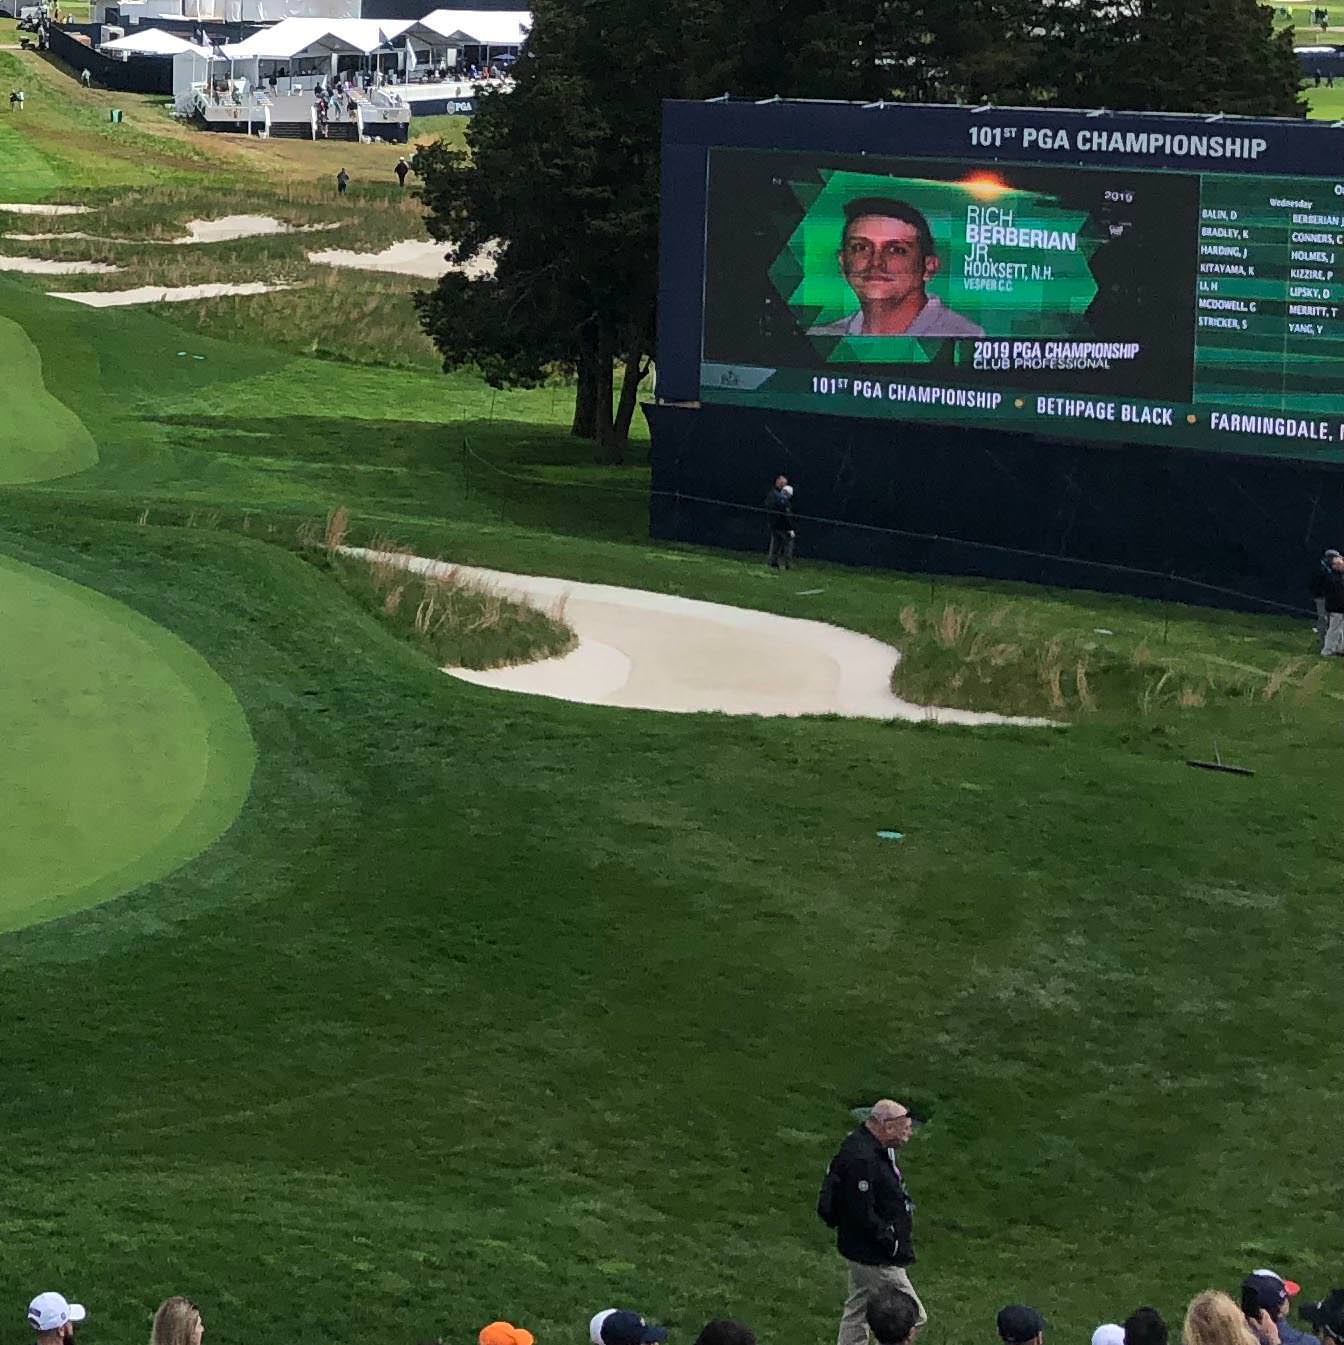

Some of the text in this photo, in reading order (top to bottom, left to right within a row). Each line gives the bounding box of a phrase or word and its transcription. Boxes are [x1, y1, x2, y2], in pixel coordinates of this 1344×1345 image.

[968, 126, 1267, 159] 101ST PGA CHAMPIONSHIP
[967, 205, 1013, 227] RICH
[965, 224, 1076, 251] BERBERIAN
[964, 243, 993, 262] JR.
[973, 341, 1140, 360] 2019 PGA CHAMPIONSHIP
[973, 358, 1111, 370] CLUB PROFESSIONAL
[812, 376, 1002, 410] 101ST PGA CHAMPIONSHIP
[1037, 396, 1116, 421] BETHPAGE
[1121, 404, 1173, 426] BLACK
[1210, 412, 1333, 442] FARMINGDALE,
